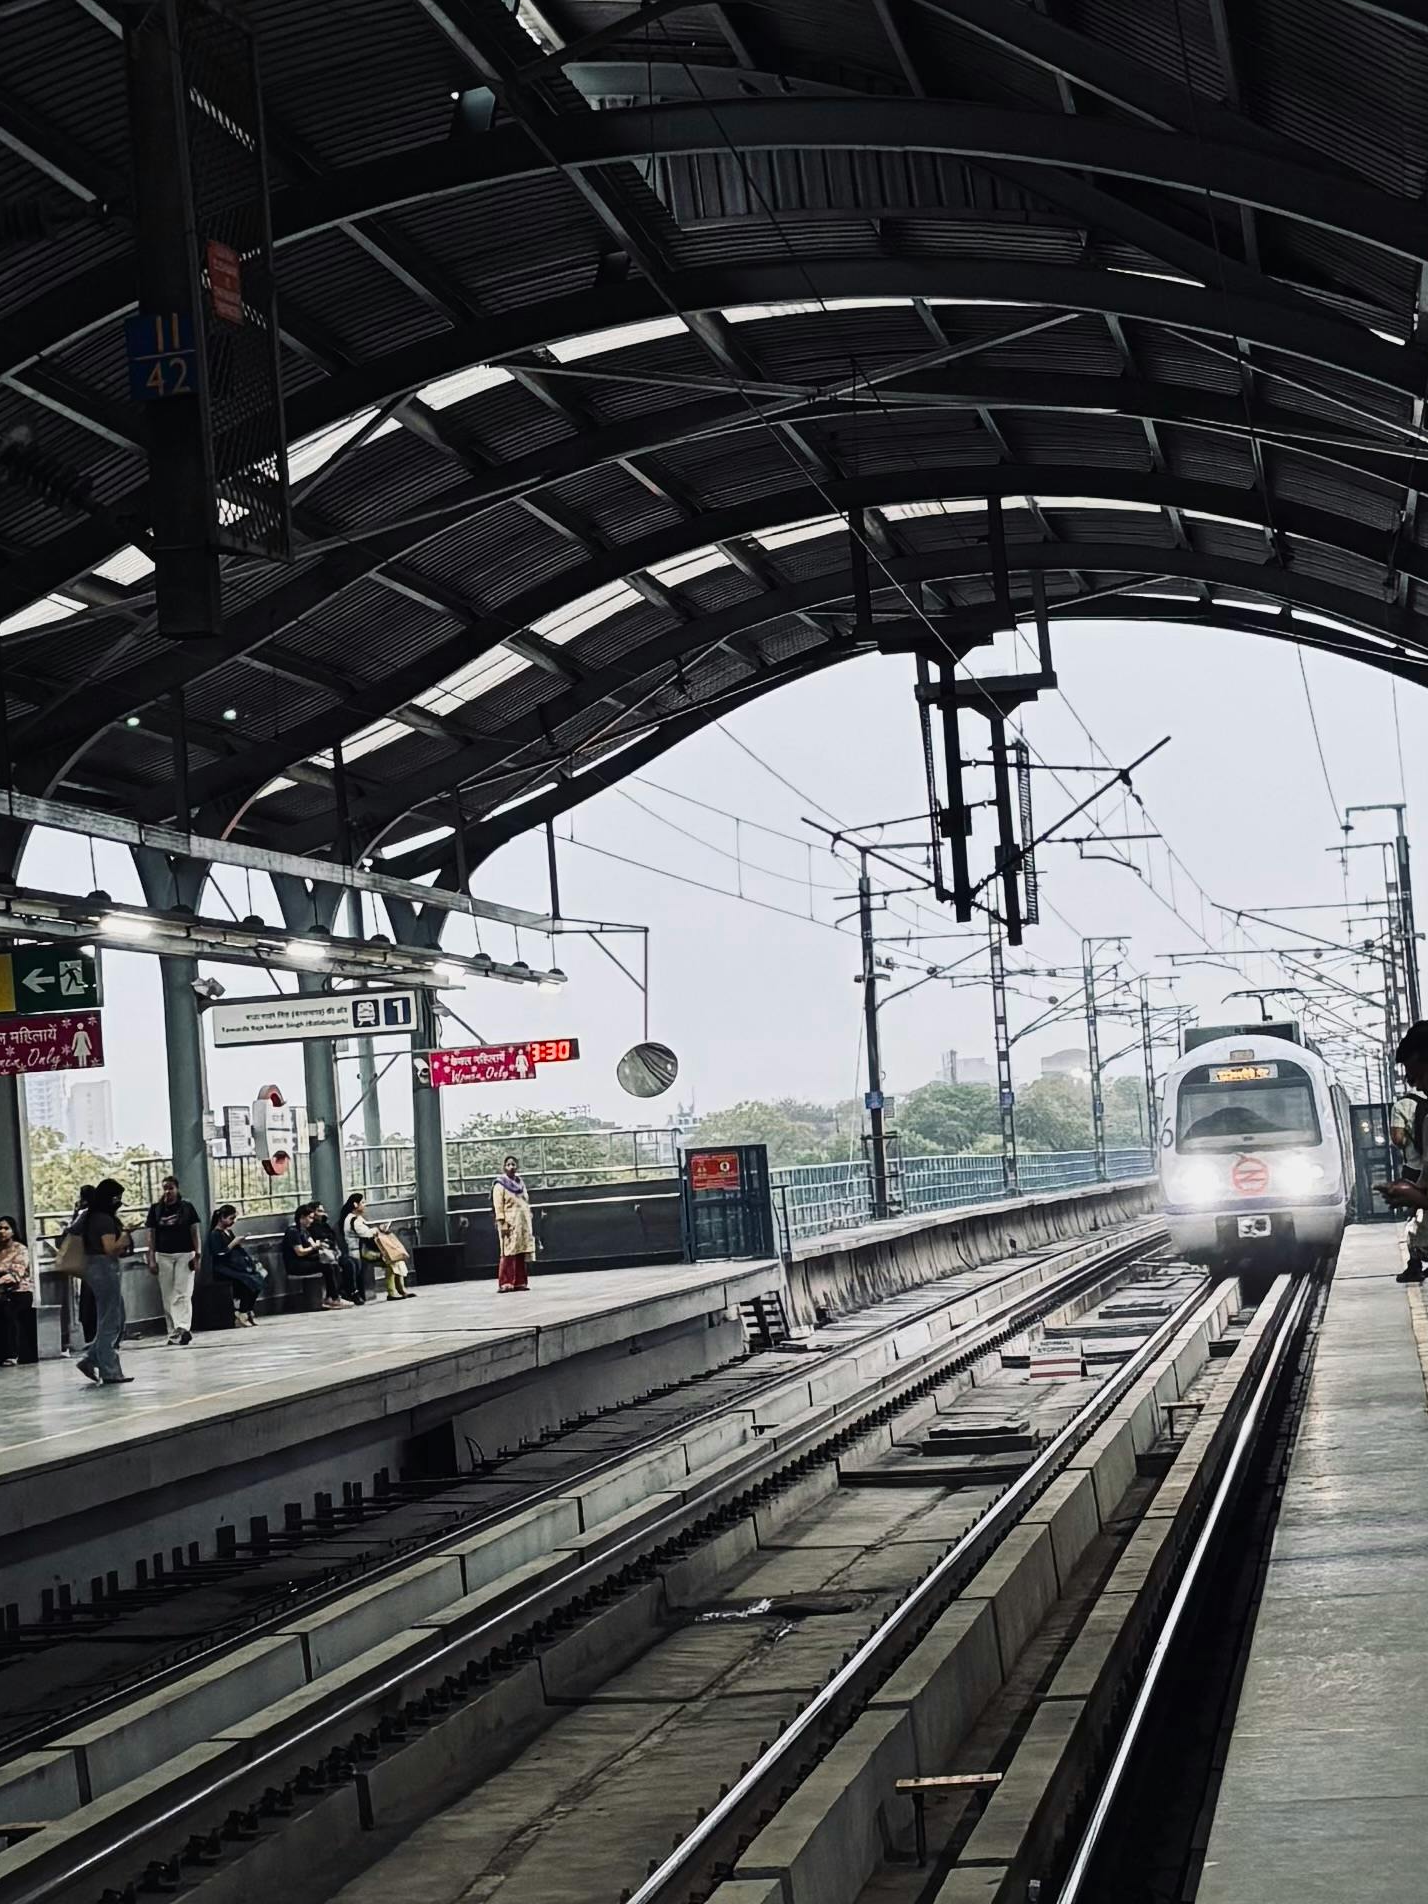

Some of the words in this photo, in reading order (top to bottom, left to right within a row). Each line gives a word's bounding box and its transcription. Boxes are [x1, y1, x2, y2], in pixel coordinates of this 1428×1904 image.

[145, 357, 192, 397] 42
[392, 1000, 404, 1024] 1
[27, 1046, 62, 1070] Only
